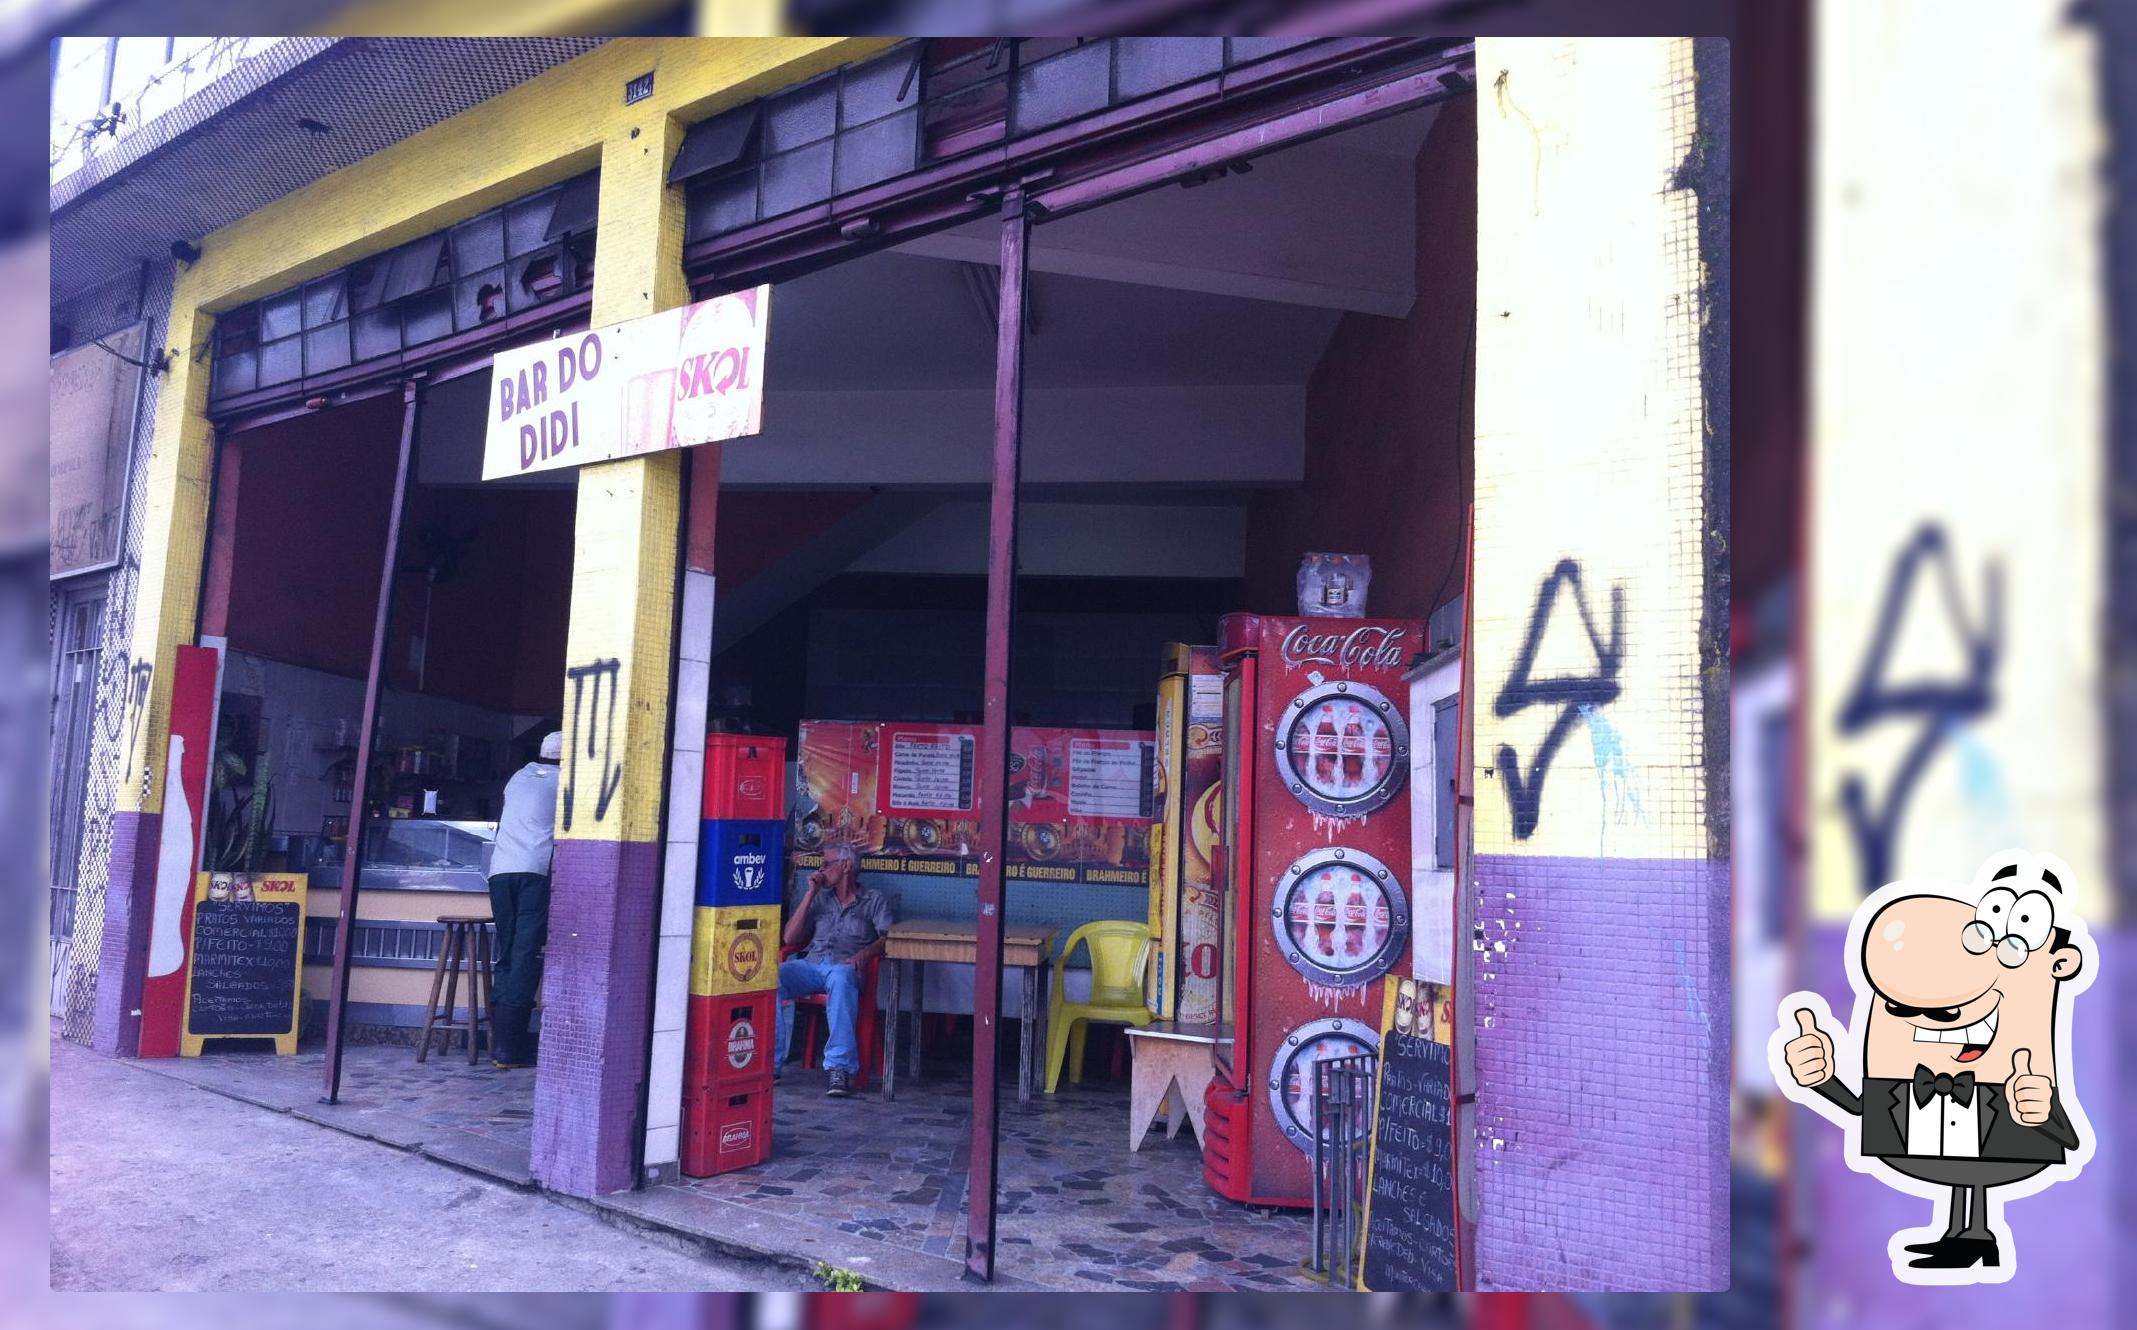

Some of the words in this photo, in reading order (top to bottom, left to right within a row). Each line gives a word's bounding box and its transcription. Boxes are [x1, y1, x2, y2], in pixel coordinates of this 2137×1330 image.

[500, 360, 548, 422] BAR
[558, 333, 601, 394] DO
[678, 346, 750, 400] SKOL
[520, 401, 579, 471] DIDI
[734, 853, 766, 865] ambev
[861, 858, 899, 871] AHMEIRO
[908, 860, 956, 874] GUERREIRO
[1027, 865, 1076, 880] GUERREIRO
[1086, 869, 1139, 882] BRAHMEIRO
[261, 880, 296, 892] SKOL
[193, 953, 253, 967] MARMITEX
[734, 952, 757, 963] SKOL
[1397, 1035, 1450, 1065] SERVIMO
